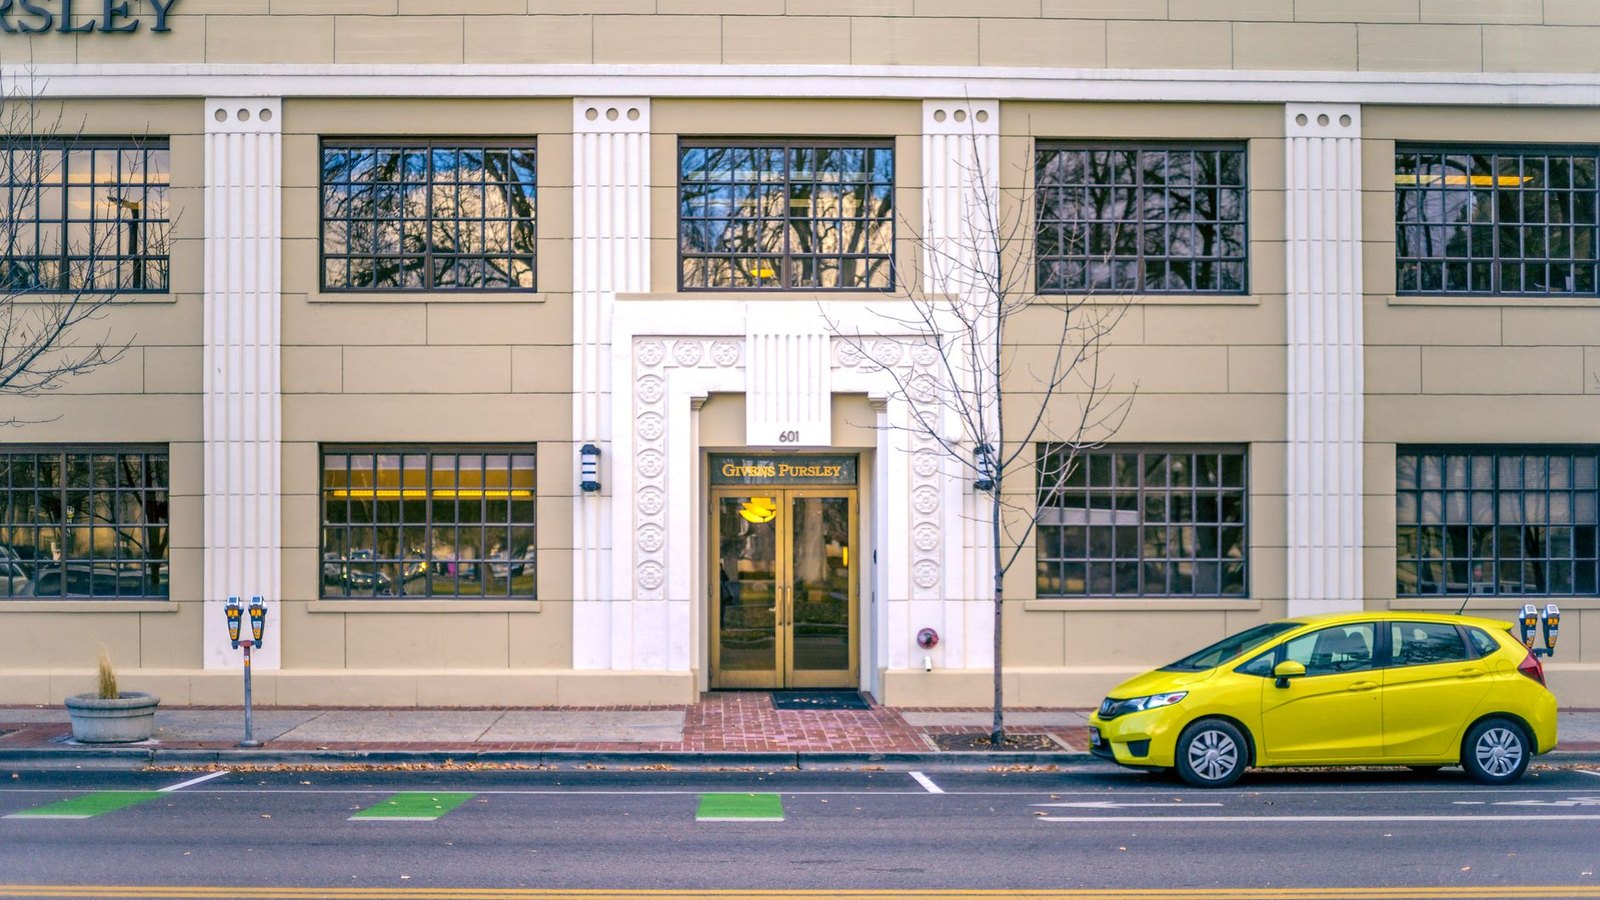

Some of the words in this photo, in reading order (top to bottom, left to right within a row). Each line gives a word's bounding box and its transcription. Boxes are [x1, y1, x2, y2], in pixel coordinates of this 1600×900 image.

[779, 430, 799, 443] 601
[722, 463, 776, 477] GIVENS
[778, 463, 842, 477] PURSLEY
